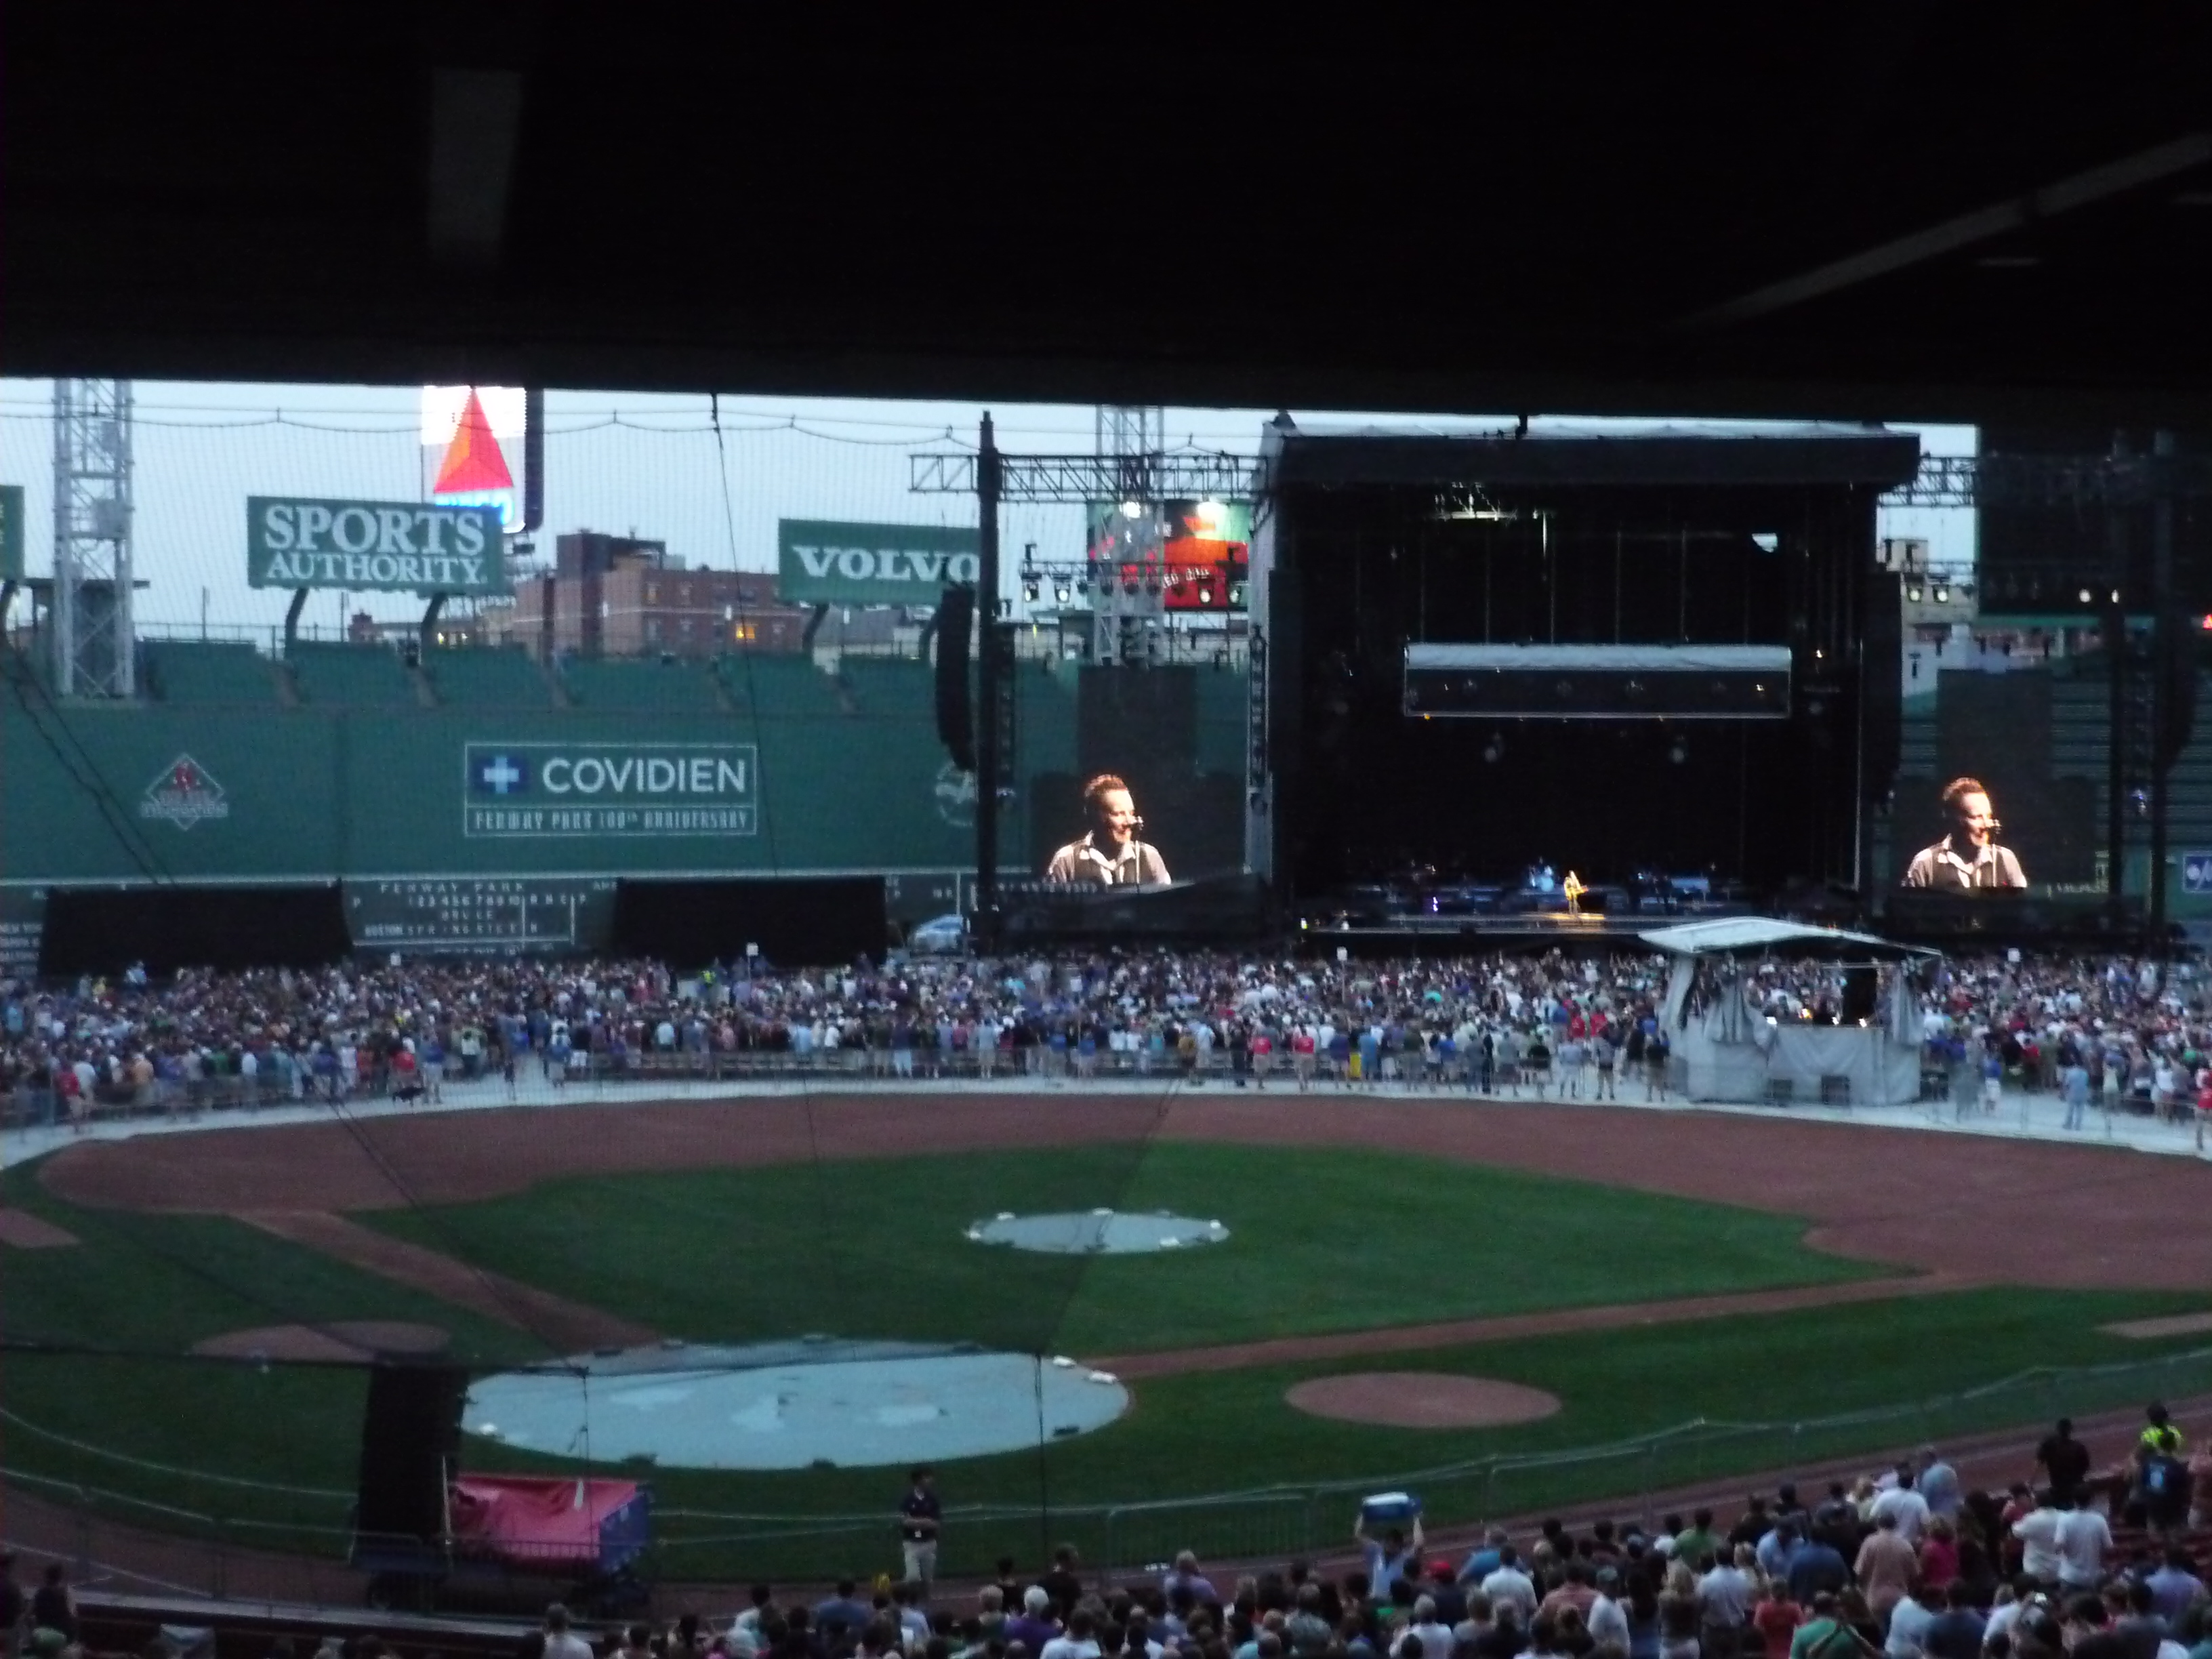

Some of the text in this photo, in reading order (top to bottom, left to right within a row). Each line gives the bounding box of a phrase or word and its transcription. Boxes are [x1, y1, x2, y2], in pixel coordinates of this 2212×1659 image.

[264, 504, 485, 556] SPORTS
[792, 546, 980, 583] VOLVO
[543, 757, 745, 794] COVIDIEN
[476, 811, 542, 830] FENWAY
[552, 811, 592, 830] PARK
[380, 882, 523, 894] FENWAY PARK
